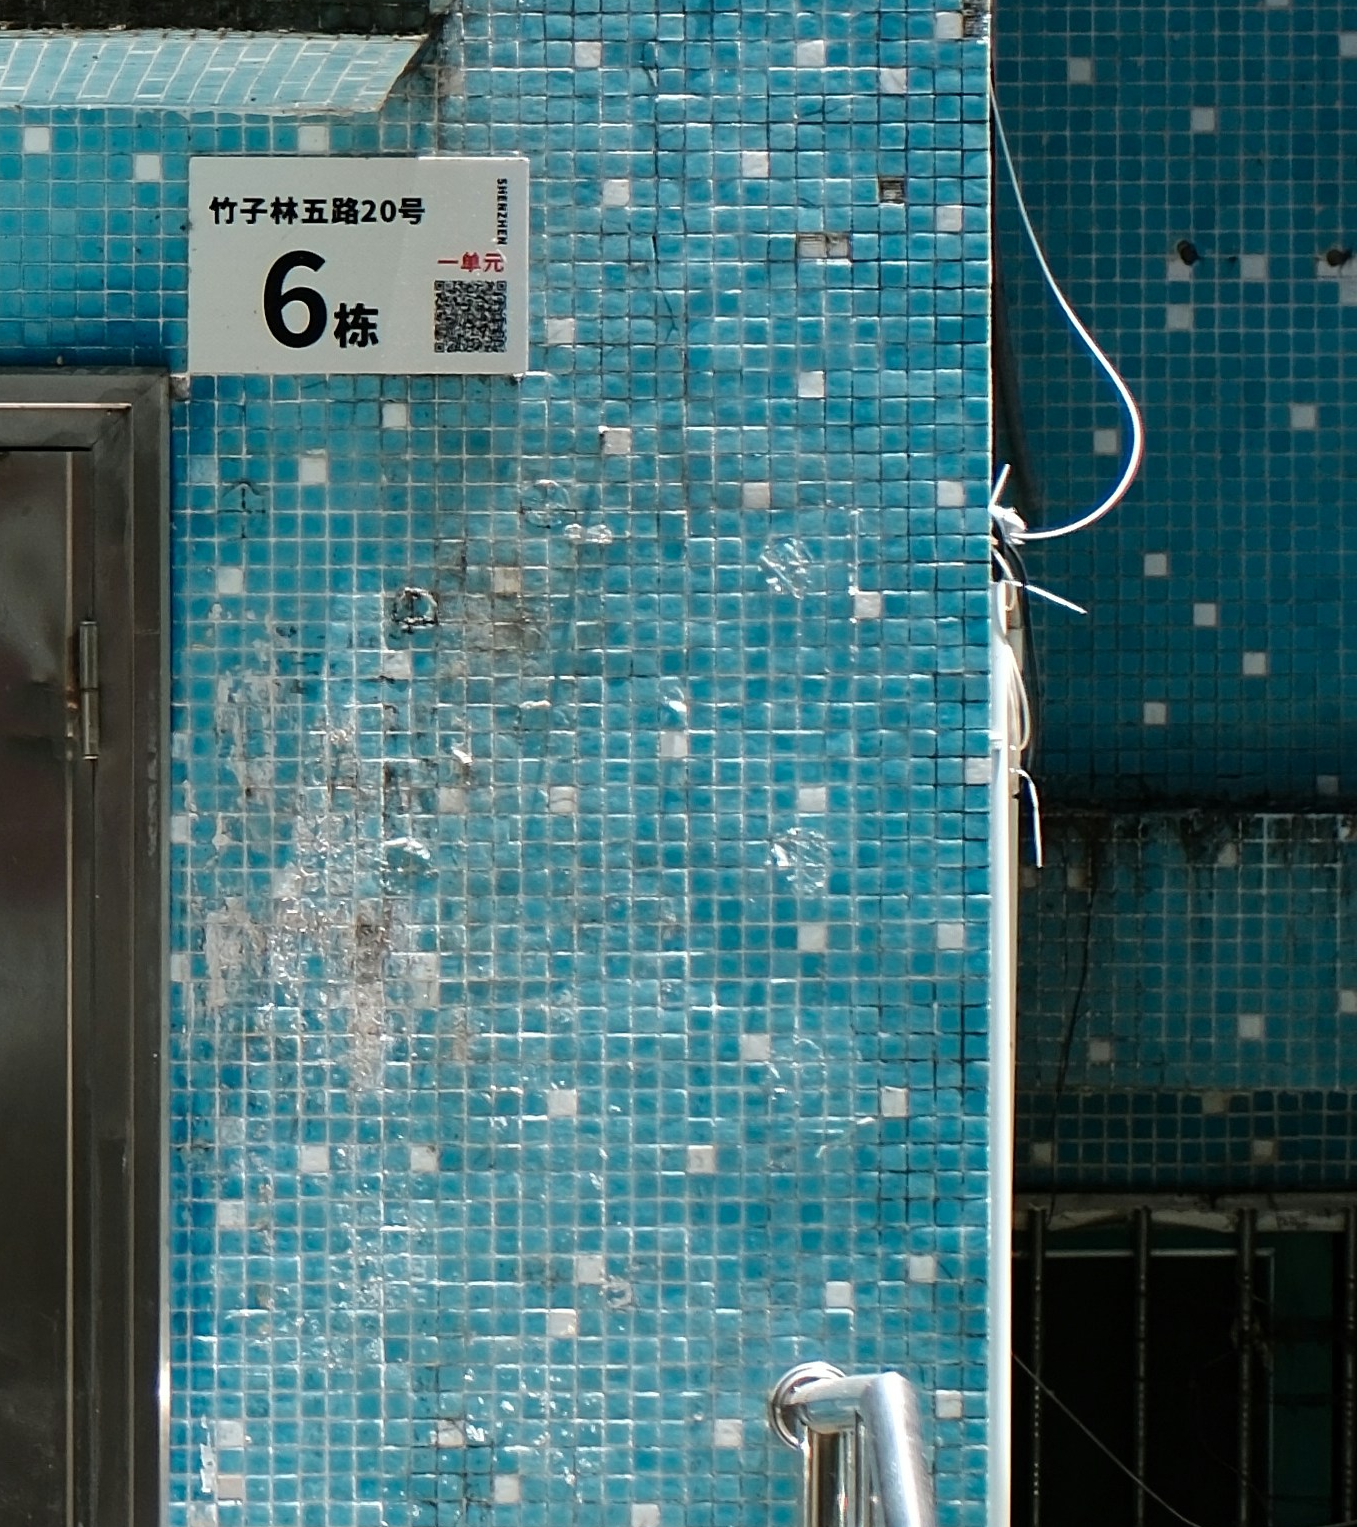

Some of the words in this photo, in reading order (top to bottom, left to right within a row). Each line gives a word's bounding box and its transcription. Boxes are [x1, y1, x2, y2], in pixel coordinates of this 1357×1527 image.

[209, 196, 426, 225] 竹子林五路20号
[497, 178, 507, 245] SHENZHEN
[437, 252, 504, 272] 一单元
[263, 250, 379, 348] 6栋
